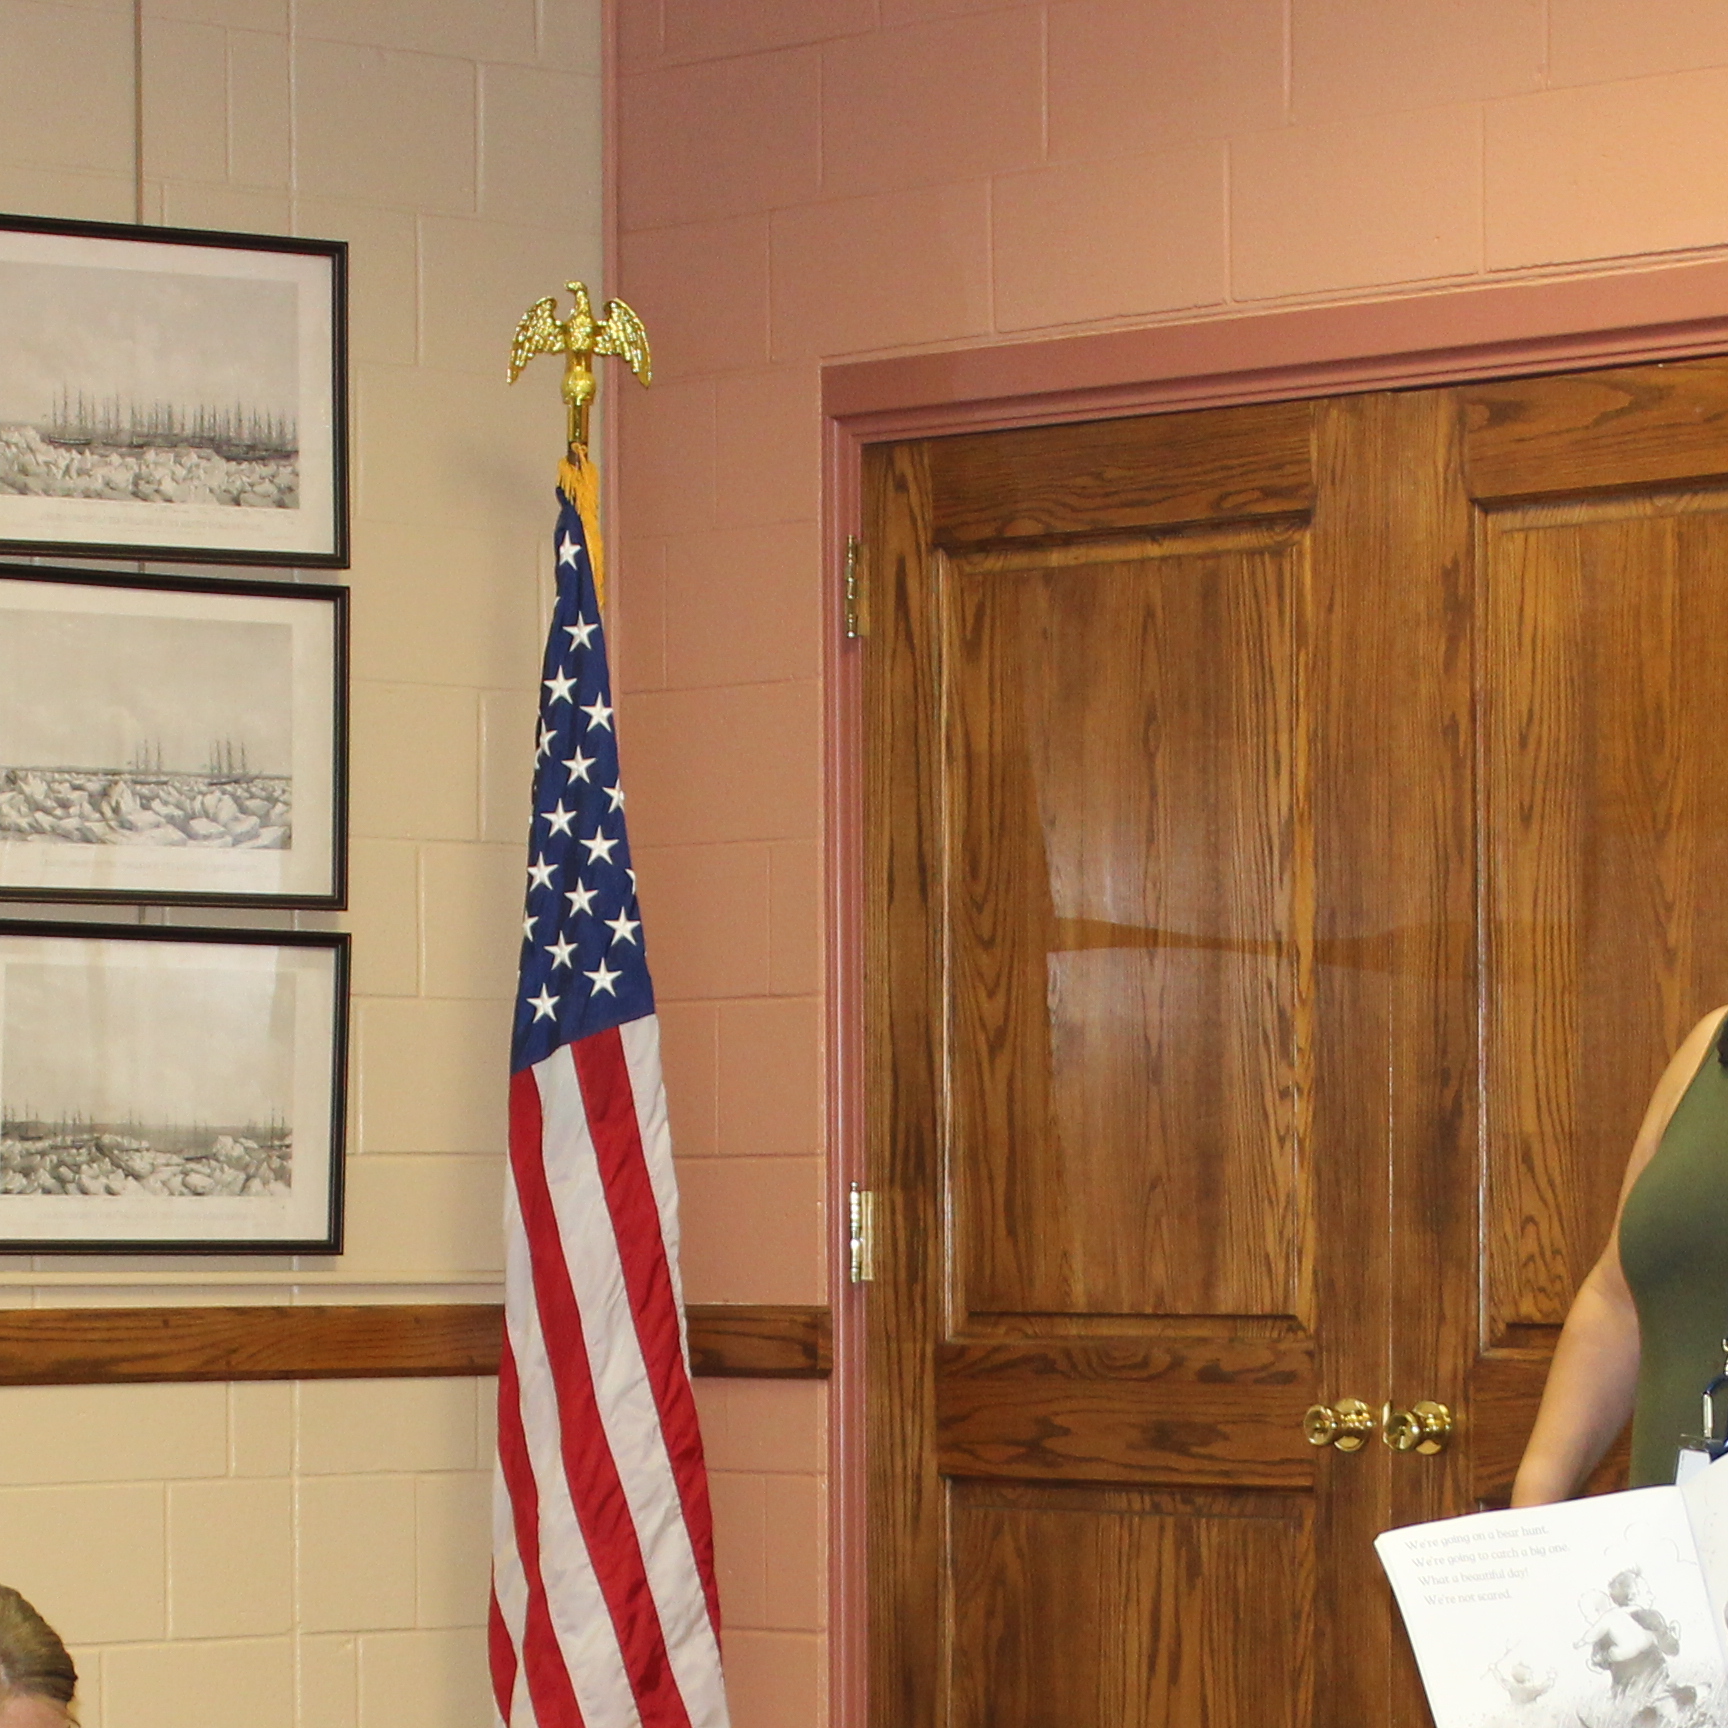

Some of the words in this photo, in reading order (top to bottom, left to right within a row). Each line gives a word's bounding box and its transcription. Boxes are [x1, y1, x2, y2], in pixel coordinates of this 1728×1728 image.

[1404, 1538, 1439, 1551] We're
[1441, 1534, 1470, 1548] going
[1472, 1532, 1486, 1541] on
[1497, 1528, 1519, 1539] bear
[1521, 1525, 1549, 1537] hunt.
[1412, 1555, 1445, 1568] We're
[1447, 1552, 1476, 1566] going
[1478, 1551, 1489, 1560] to
[1491, 1547, 1519, 1560] catch
[1529, 1543, 1546, 1557] big
[1548, 1543, 1570, 1553] one.
[1418, 1573, 1449, 1586] What
[1460, 1568, 1505, 1582] beautiful
[1507, 1566, 1529, 1580] day!
[1424, 1594, 1455, 1606] We're
[1458, 1592, 1476, 1603] not
[1477, 1588, 1512, 1602] scared.
